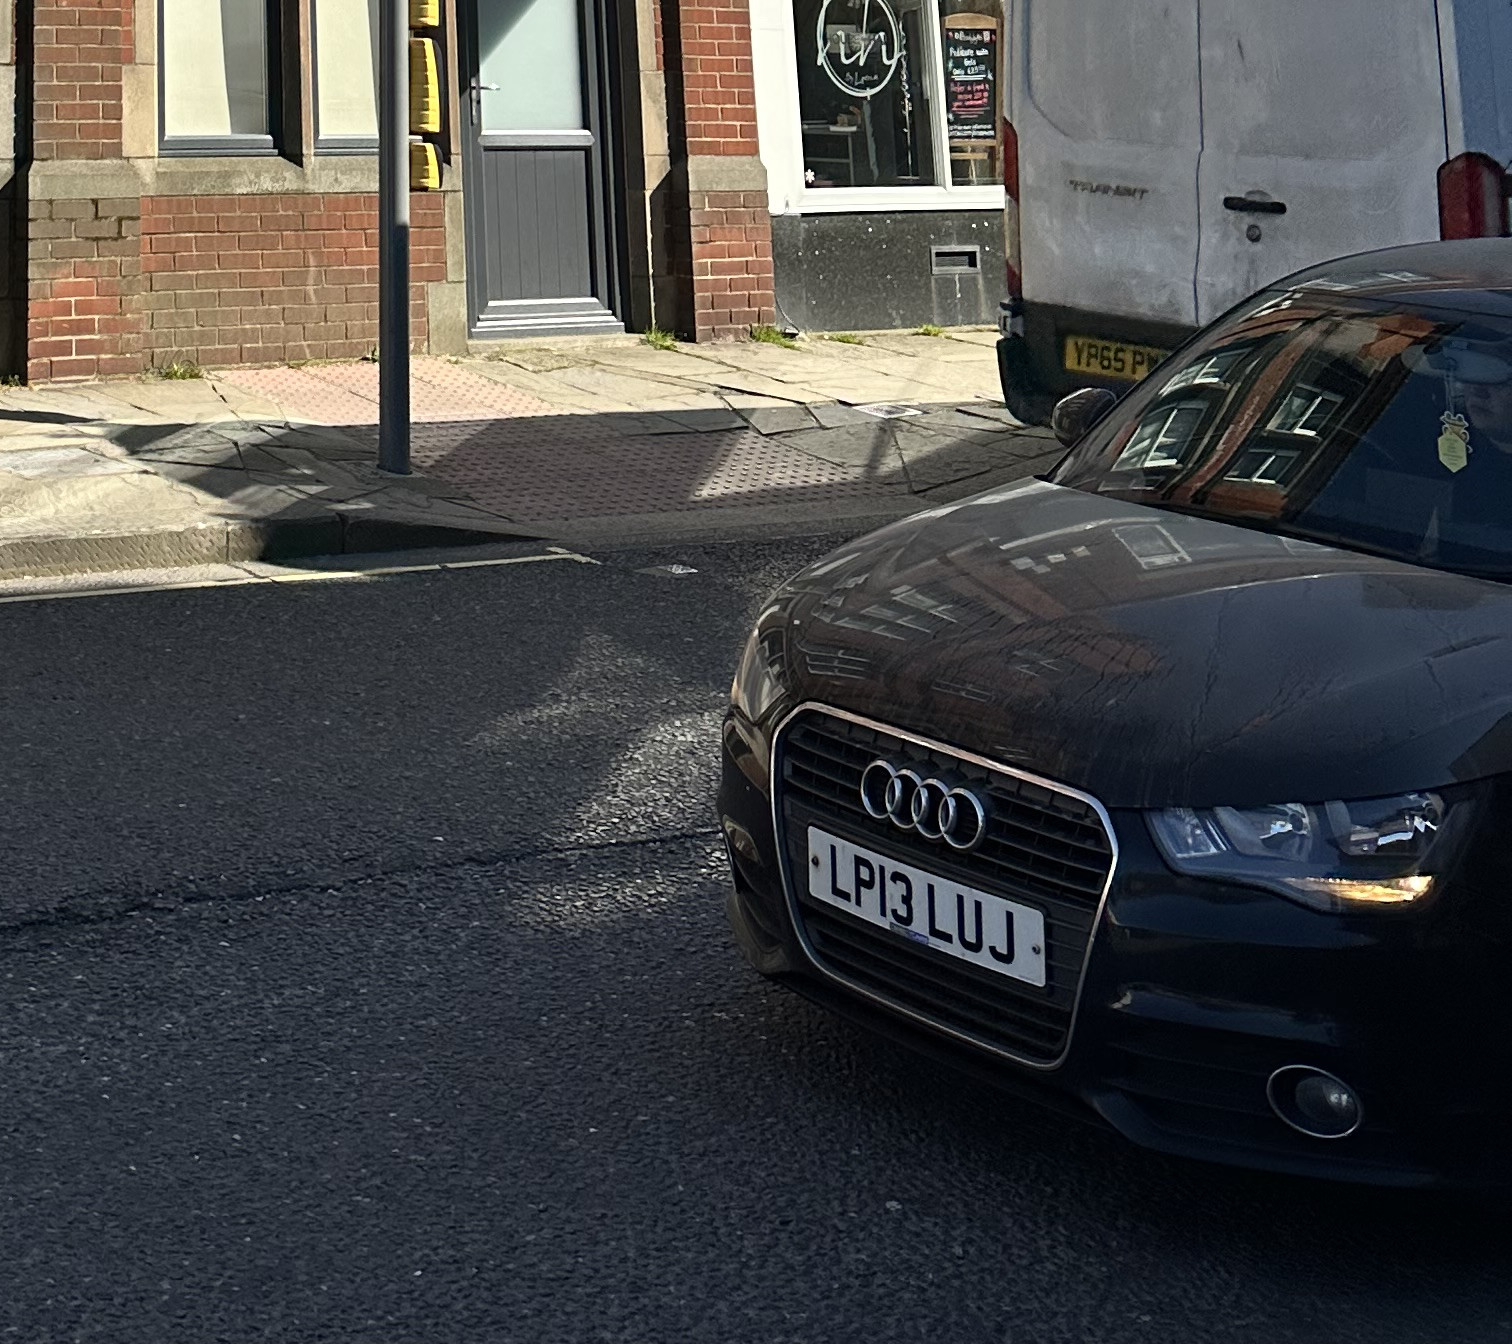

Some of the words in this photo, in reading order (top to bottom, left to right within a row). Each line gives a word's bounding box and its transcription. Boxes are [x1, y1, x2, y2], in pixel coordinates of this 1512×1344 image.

[1074, 339, 1126, 373] YP65
[829, 844, 914, 927] LP13
[926, 882, 1016, 965] LUJ
